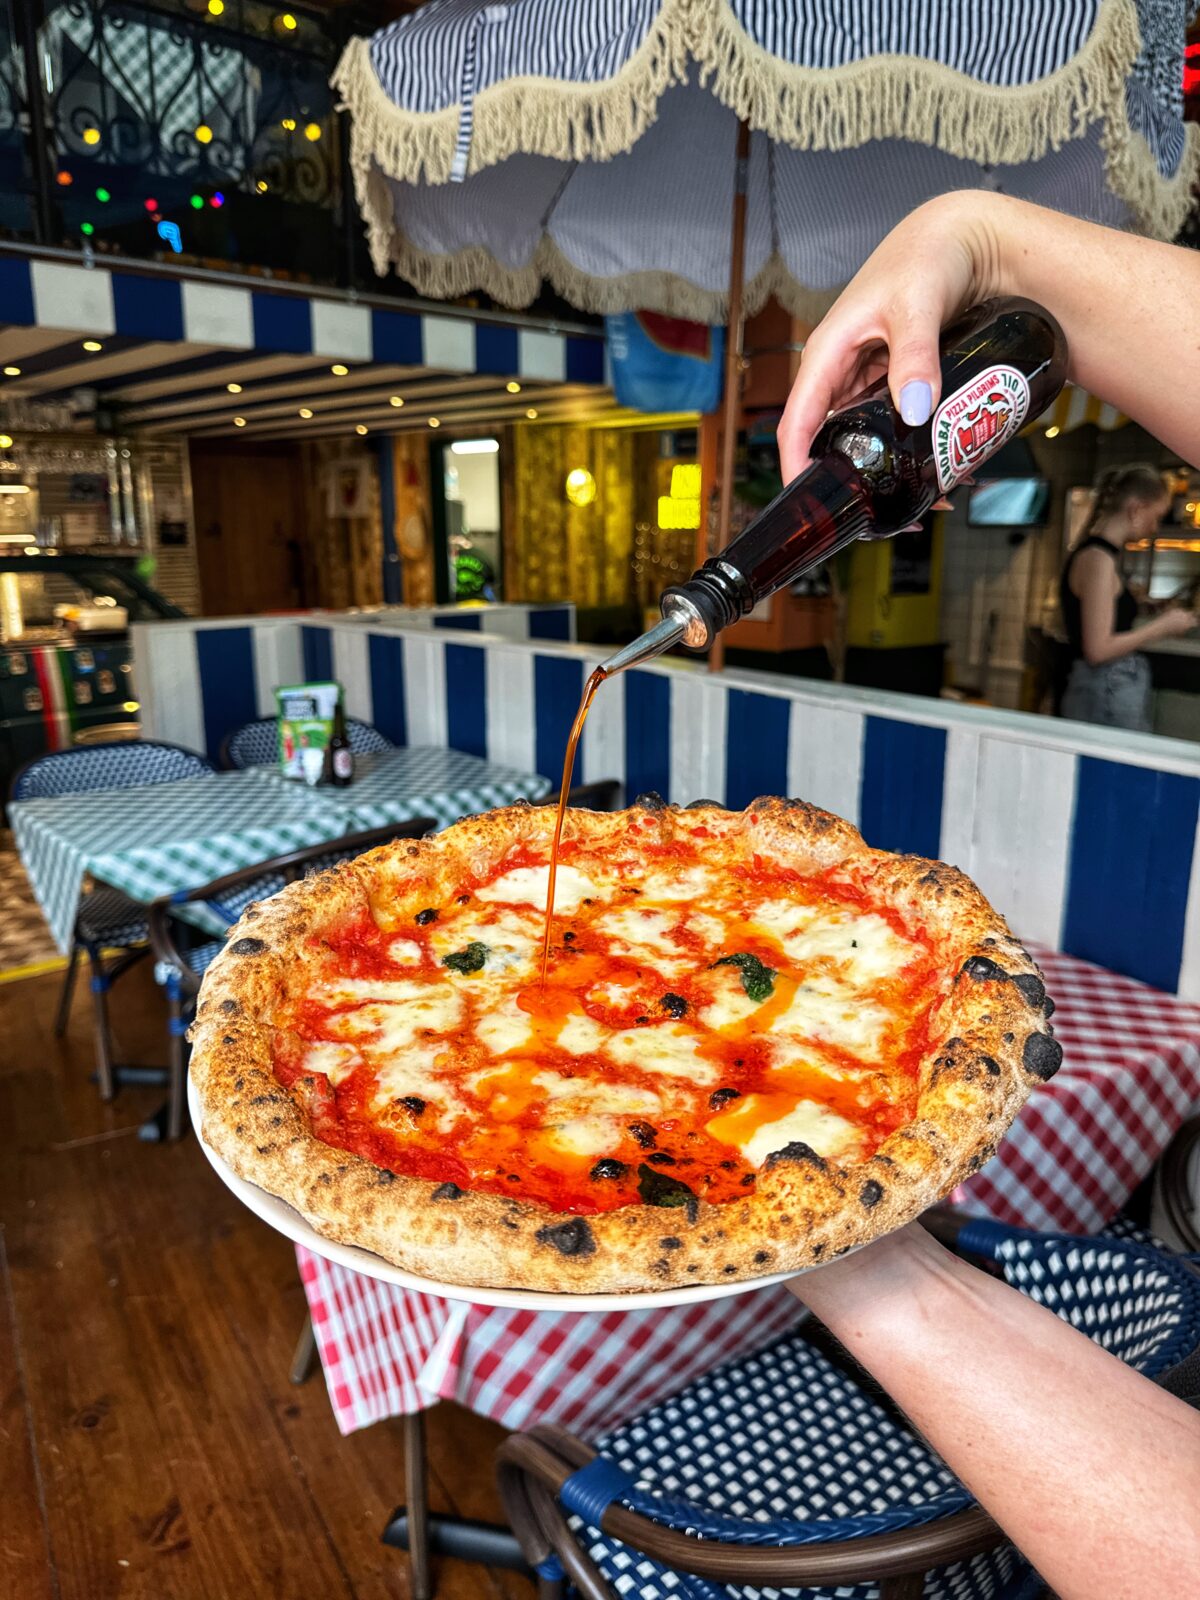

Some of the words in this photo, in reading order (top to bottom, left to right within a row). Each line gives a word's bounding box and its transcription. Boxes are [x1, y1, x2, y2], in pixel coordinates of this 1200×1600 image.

[945, 399, 968, 420] PIZZA
[967, 374, 1000, 404] PILGRIMS
[1001, 373, 1018, 392] OIL
[938, 420, 952, 479] BOMBA
